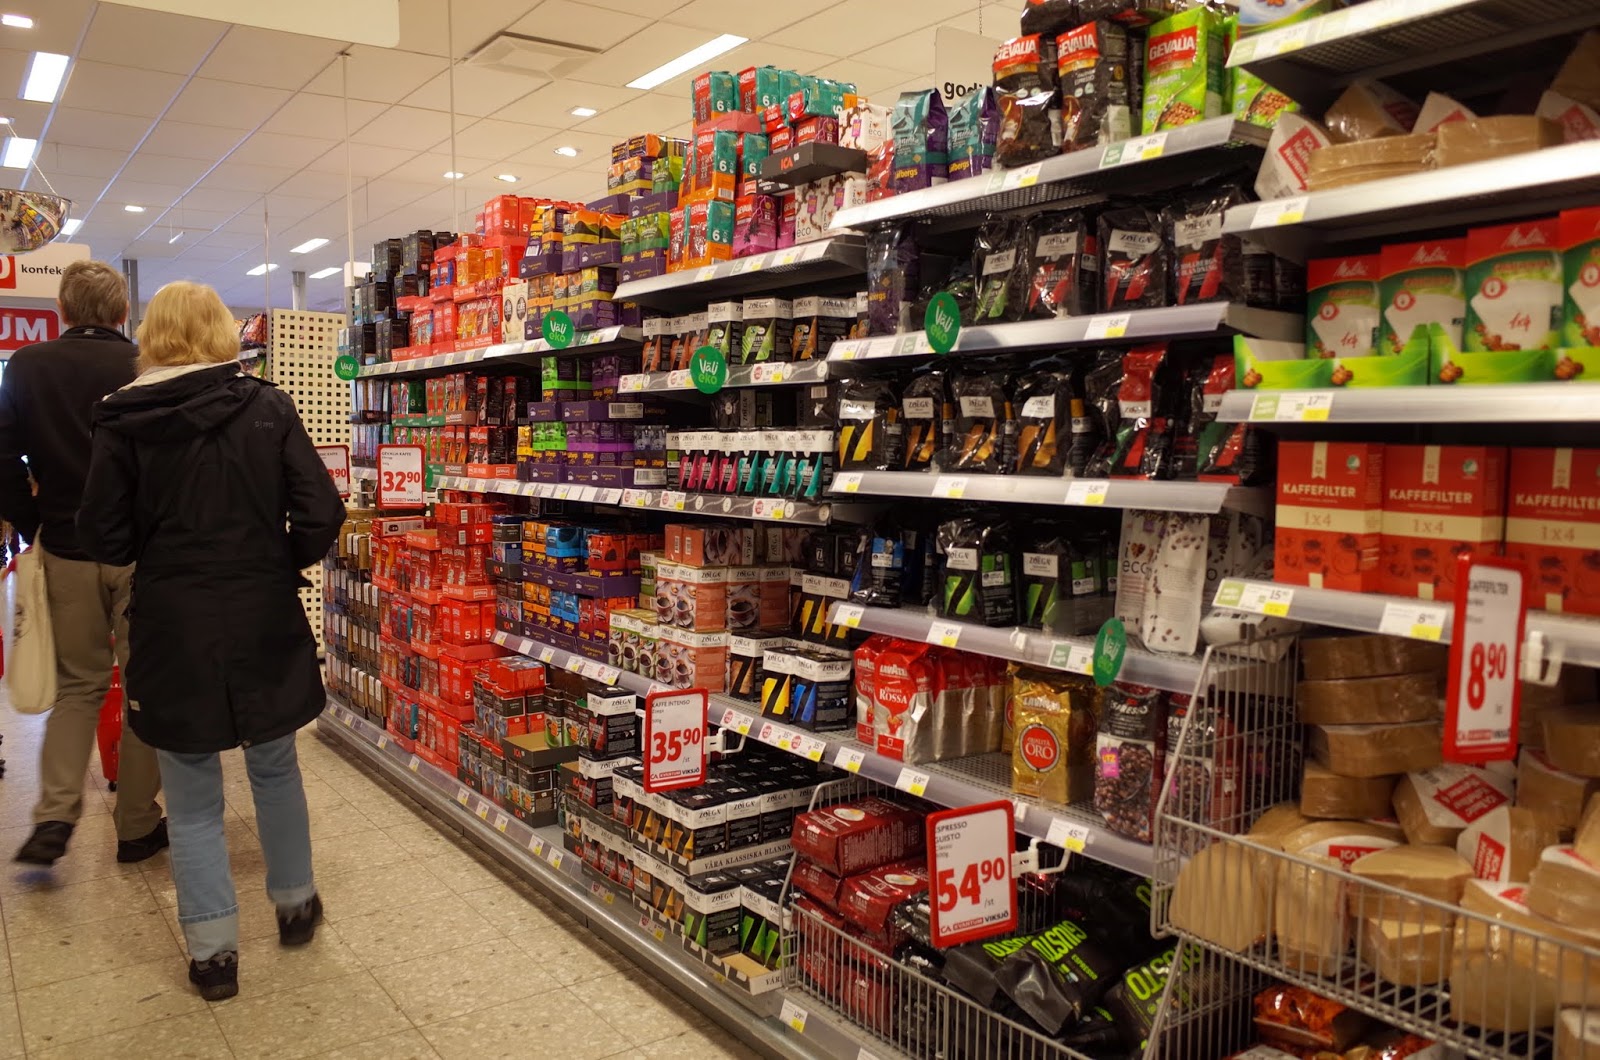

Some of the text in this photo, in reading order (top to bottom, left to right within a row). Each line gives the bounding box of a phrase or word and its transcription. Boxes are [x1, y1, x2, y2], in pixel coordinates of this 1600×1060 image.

[1058, 34, 1096, 59] GEVALIA
[1150, 36, 1196, 60] GEVALIA
[716, 100, 724, 111] 6
[762, 95, 770, 106] 6
[719, 160, 727, 172] 6
[749, 162, 757, 174] 6
[780, 157, 793, 170] ICA
[503, 219, 510, 228] 5
[522, 224, 529, 232] 5
[712, 229, 720, 241] 6
[796, 225, 812, 237] eco
[21, 263, 66, 275] konfek
[935, 305, 954, 333] Välj
[549, 331, 566, 342] eko
[699, 359, 719, 376] Välj
[698, 374, 717, 385] eko
[1283, 483, 1356, 498] KAFFEFILTER
[1389, 487, 1473, 504] KAFFEFILTER
[464, 630, 471, 640] 5
[485, 628, 491, 638] 5
[464, 690, 471, 700] 5
[879, 687, 908, 705] ROSSA
[1025, 742, 1054, 760] ORO
[937, 821, 968, 833] SPRESSO
[940, 924, 952, 934] CA
[984, 909, 1010, 922] VIKSJÖ
[1031, 920, 1088, 963] GIUSTO
[765, 977, 782, 986] VÅR
